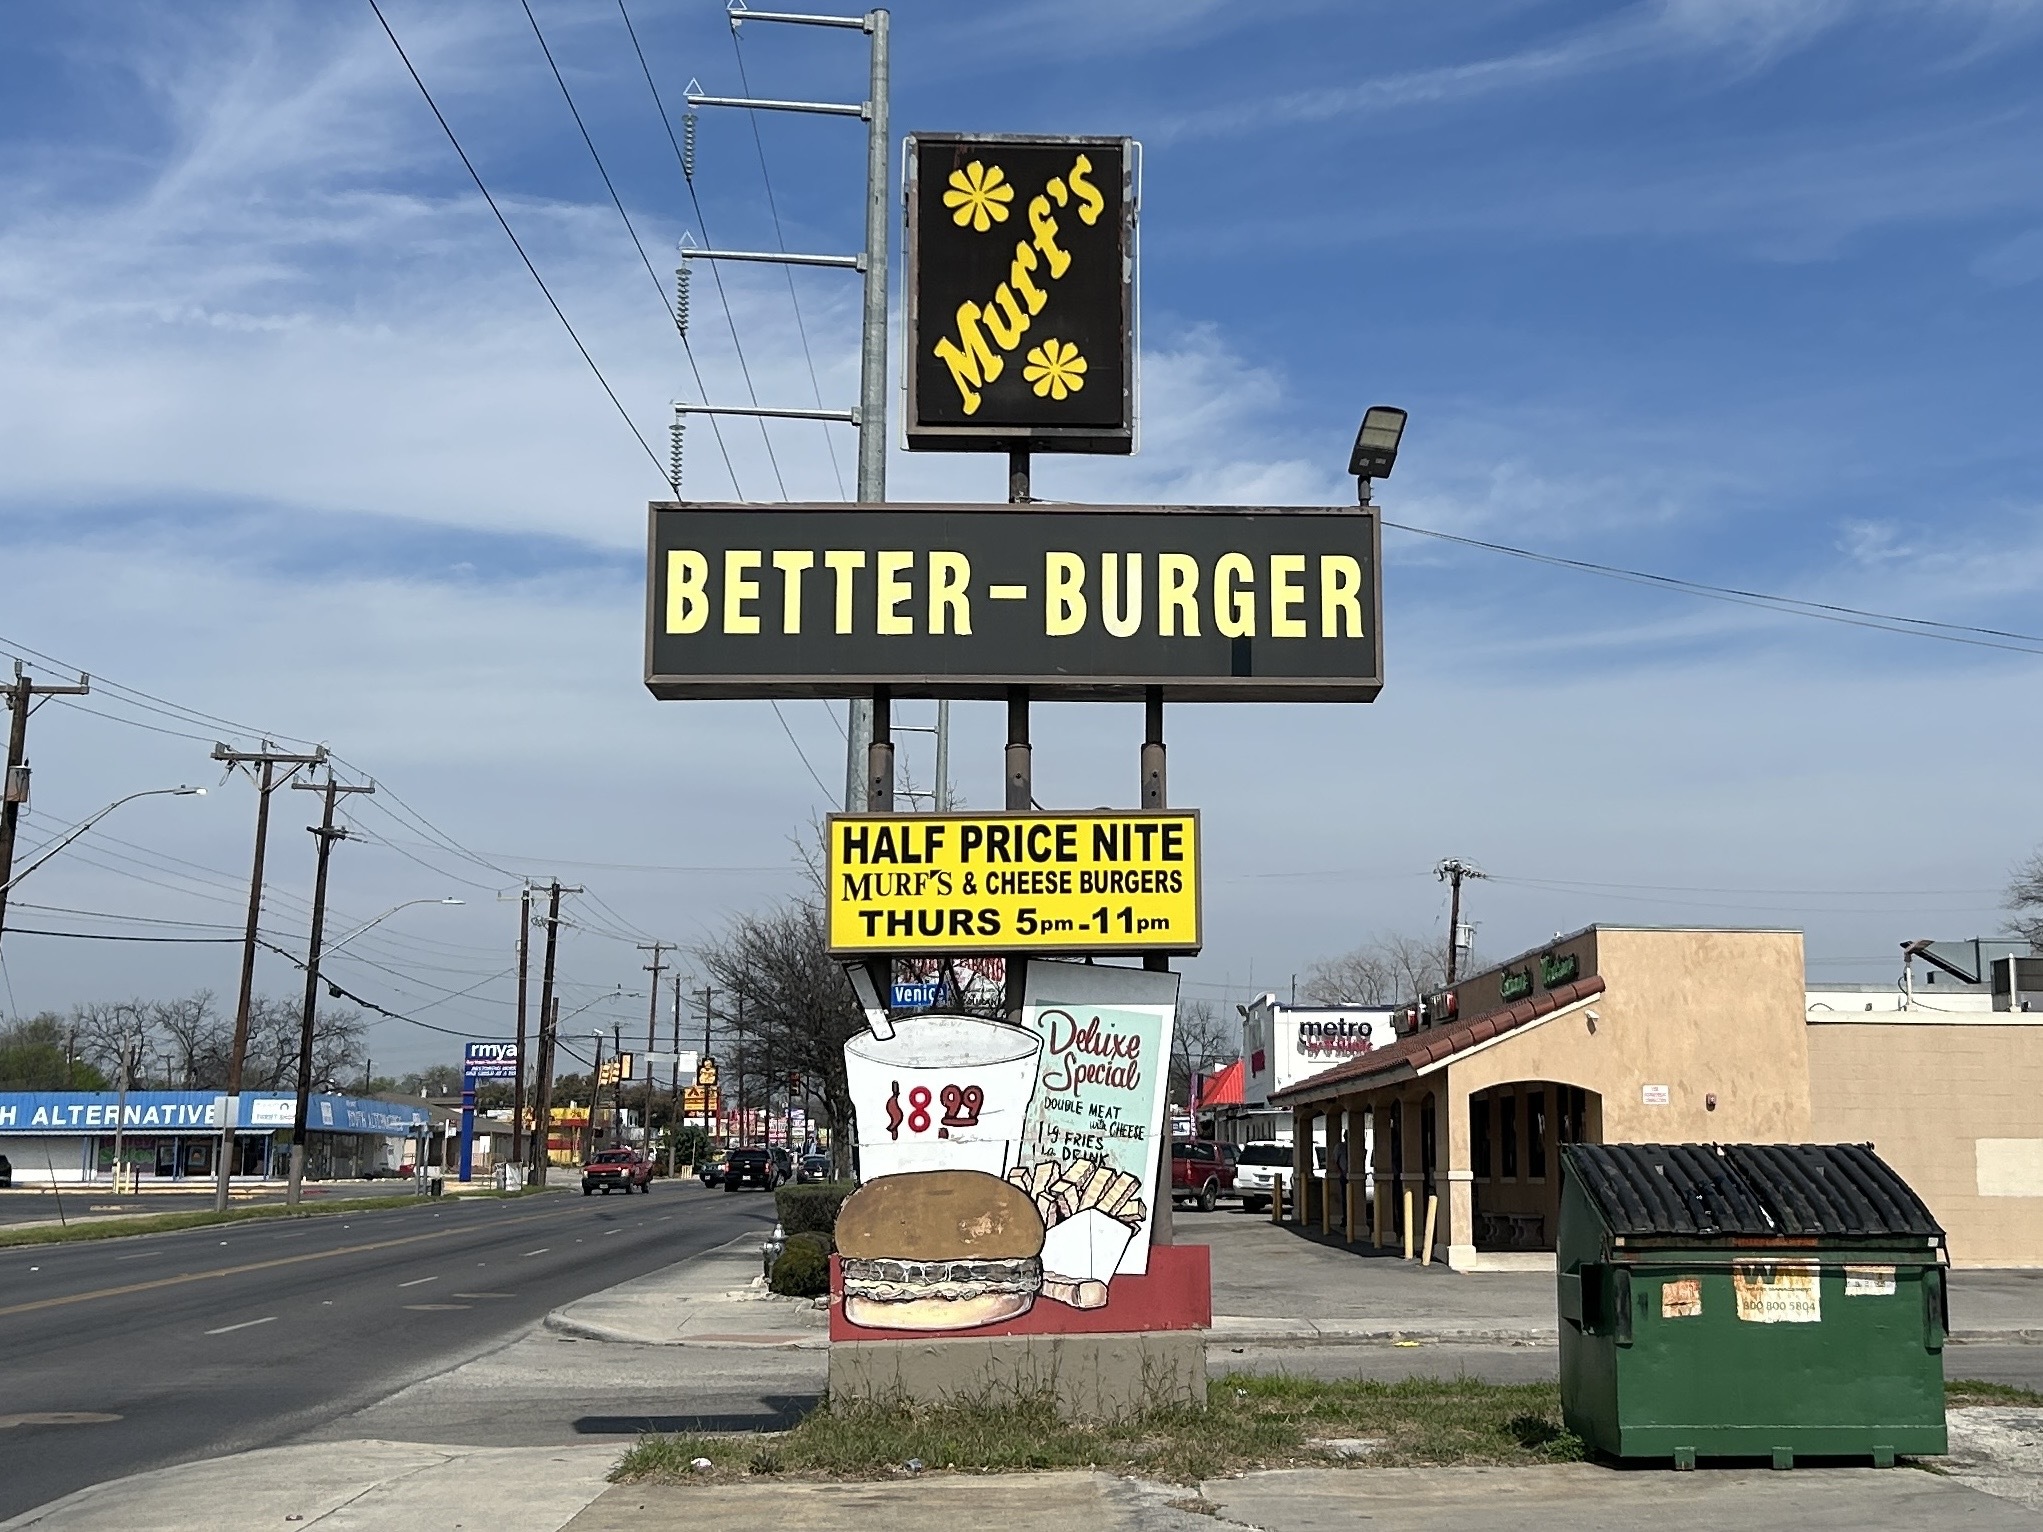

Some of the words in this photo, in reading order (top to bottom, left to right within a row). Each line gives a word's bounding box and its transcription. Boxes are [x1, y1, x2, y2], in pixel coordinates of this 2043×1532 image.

[934, 154, 1104, 415] Murf's
[843, 825, 945, 864] HALF
[961, 824, 1078, 863] PRICE
[1092, 823, 1184, 862] NITE
[841, 870, 952, 901] MURF'S
[962, 875, 978, 895] &
[986, 870, 1072, 895] CHEESE
[1080, 869, 1183, 894] BURGERS
[859, 907, 1001, 937] THURS
[1038, 1010, 1141, 1060] Deluxe
[1299, 1018, 1373, 1036] metro
[1042, 1051, 1141, 1097] Special
[1044, 1096, 1083, 1115] DOUBLE
[1089, 1103, 1122, 1119] MEAT
[1064, 1132, 1105, 1151] FRIES
[1109, 1120, 1146, 1141] CHEESE
[1062, 1146, 1110, 1167] DRINK
[1743, 1300, 1764, 1311] 800
[1766, 1300, 1787, 1311] 800
[1790, 1300, 1816, 1311] 5804
